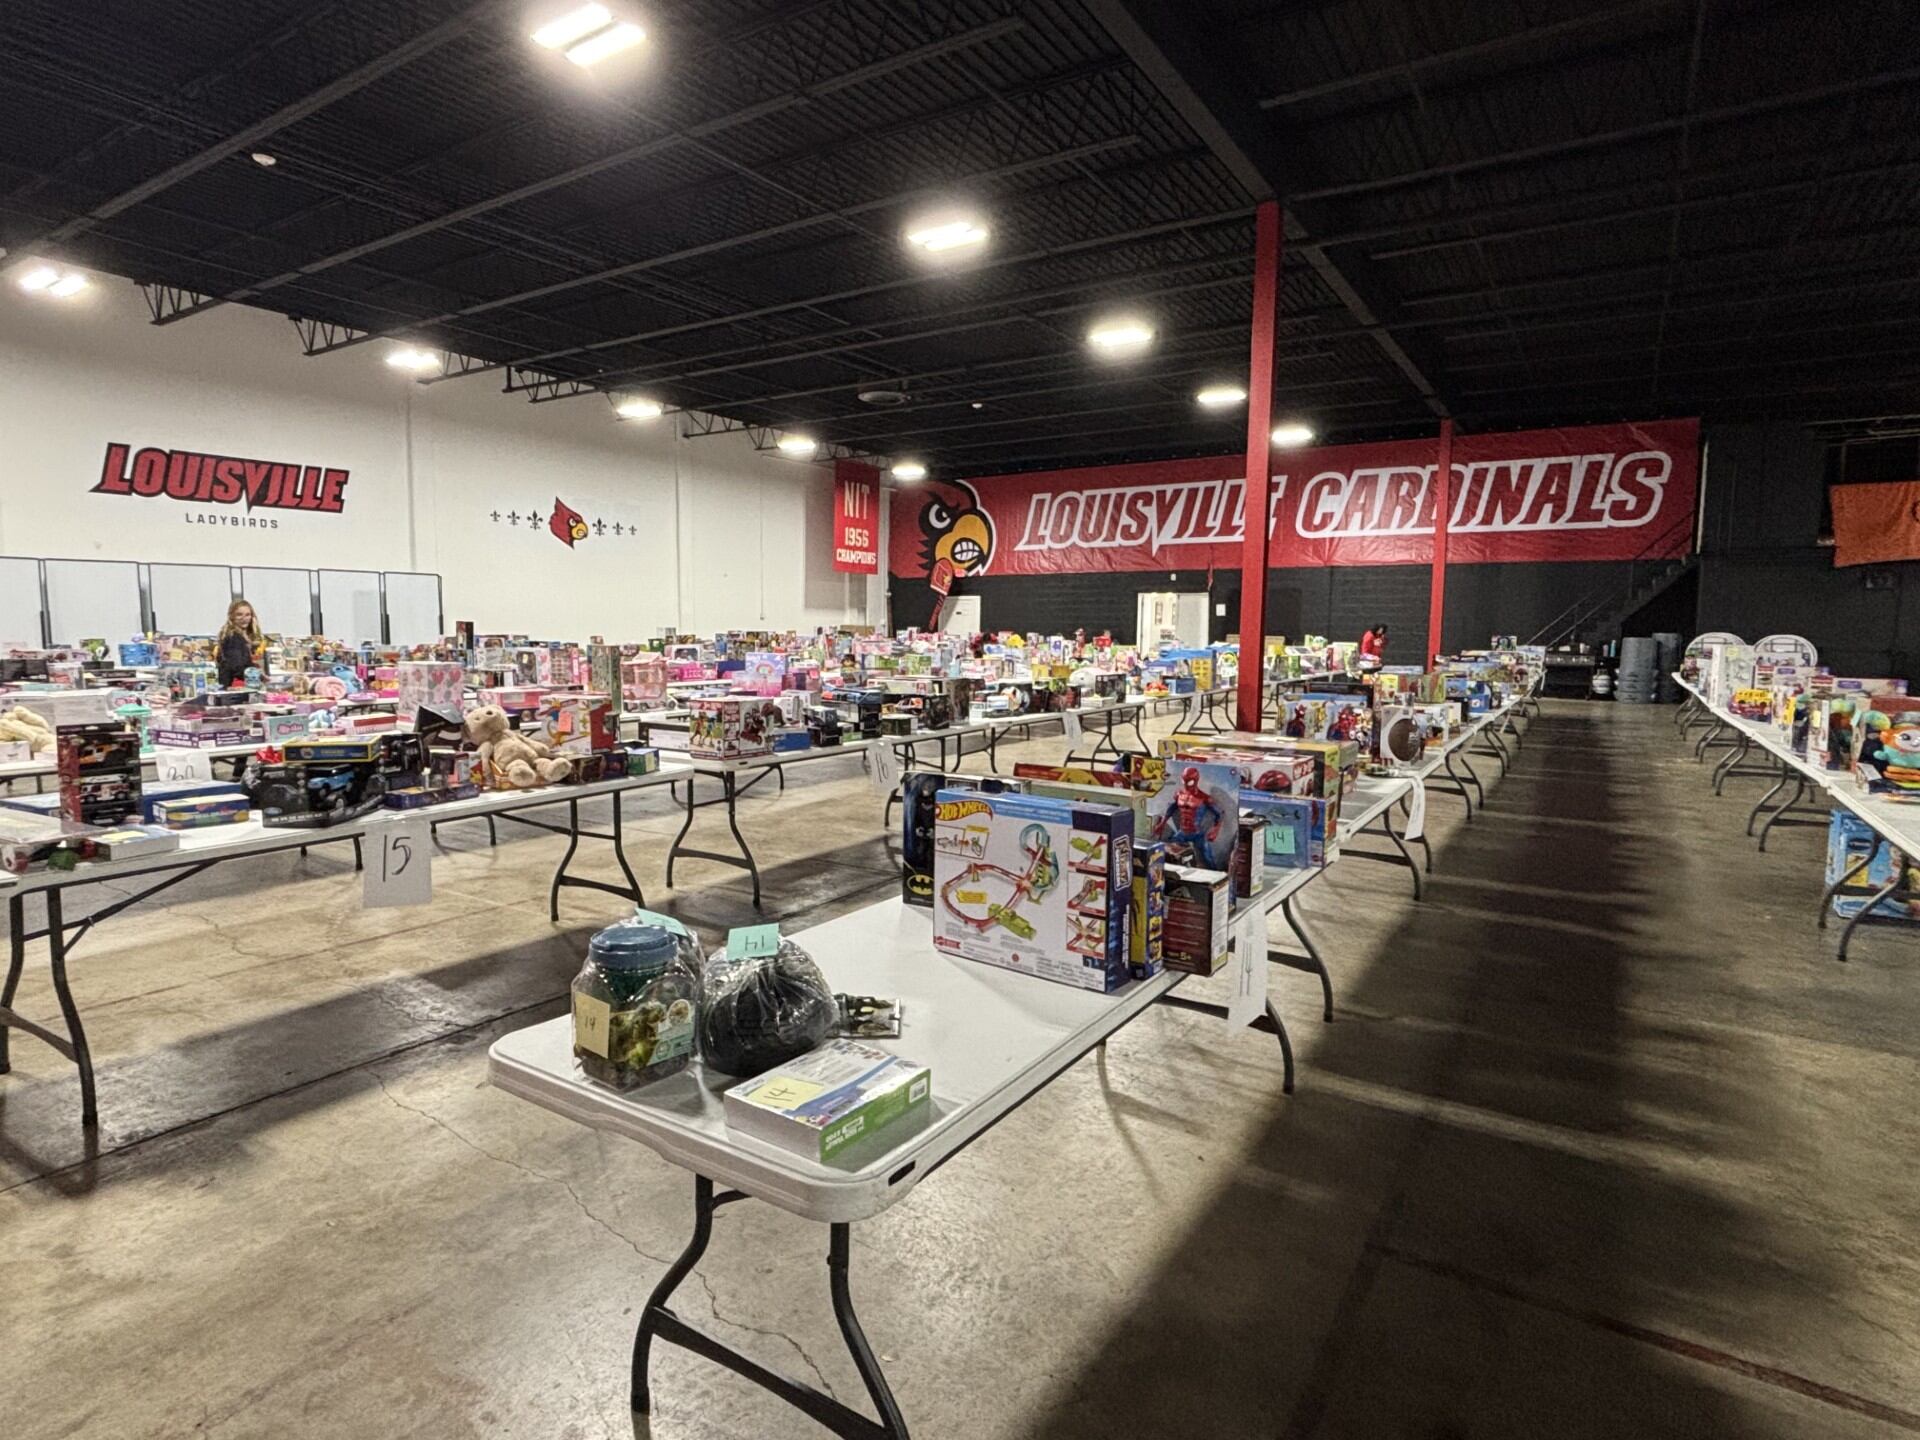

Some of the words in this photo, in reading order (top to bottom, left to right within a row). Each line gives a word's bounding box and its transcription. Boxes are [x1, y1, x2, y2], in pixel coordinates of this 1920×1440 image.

[88, 442, 350, 514] LOUISVILLE
[844, 480, 870, 520] NIT
[1295, 451, 1673, 539] CARDINALS
[185, 512, 279, 529] LADYBIRDS
[844, 526, 870, 548] 1956
[836, 548, 877, 565] CHAMPIONS
[940, 803, 959, 819] HOT
[1272, 831, 1285, 844] 14
[382, 834, 412, 883] 15
[584, 1014, 596, 1031] 14
[763, 1087, 796, 1102] 14
